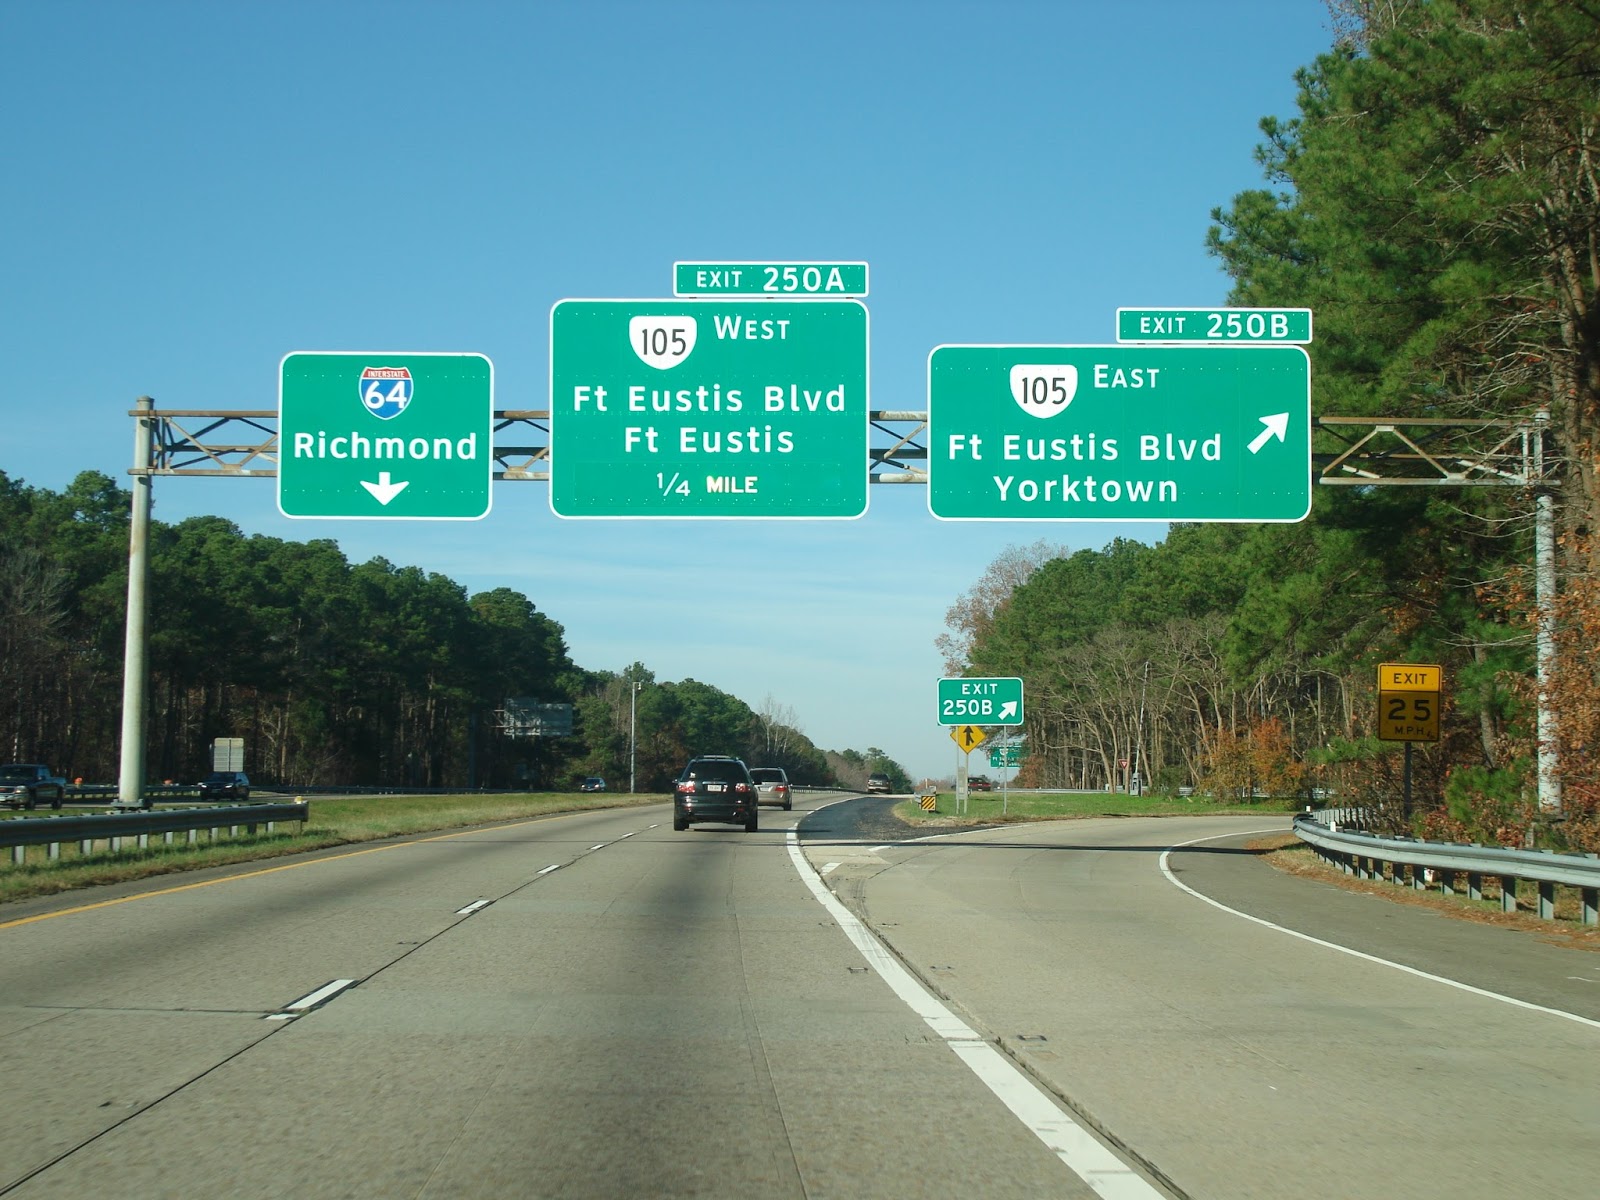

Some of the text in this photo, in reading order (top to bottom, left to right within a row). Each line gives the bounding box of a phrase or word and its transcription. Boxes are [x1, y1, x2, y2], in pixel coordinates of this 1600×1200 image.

[696, 267, 845, 292] EXIT 250A
[714, 315, 790, 340] WEST
[1140, 313, 1289, 338] EXIT 250B
[640, 328, 688, 357] 105
[367, 370, 405, 378] INTERSTATE
[1093, 364, 1160, 389] EAST
[364, 380, 408, 409] 64
[574, 384, 846, 412] Ft Eustis Blvd
[1021, 376, 1068, 405] 105
[294, 430, 477, 460] Richmond
[625, 425, 794, 453] Ft Eustis
[949, 432, 1221, 461] Ft Eustis Blvd
[706, 475, 758, 494] MILE
[993, 475, 1178, 502] Yorktown
[962, 683, 998, 695] EXIT
[1393, 673, 1427, 685] EXIT
[943, 699, 993, 716] 250B
[1388, 698, 1431, 721] 25
[1394, 725, 1424, 736] MPH
